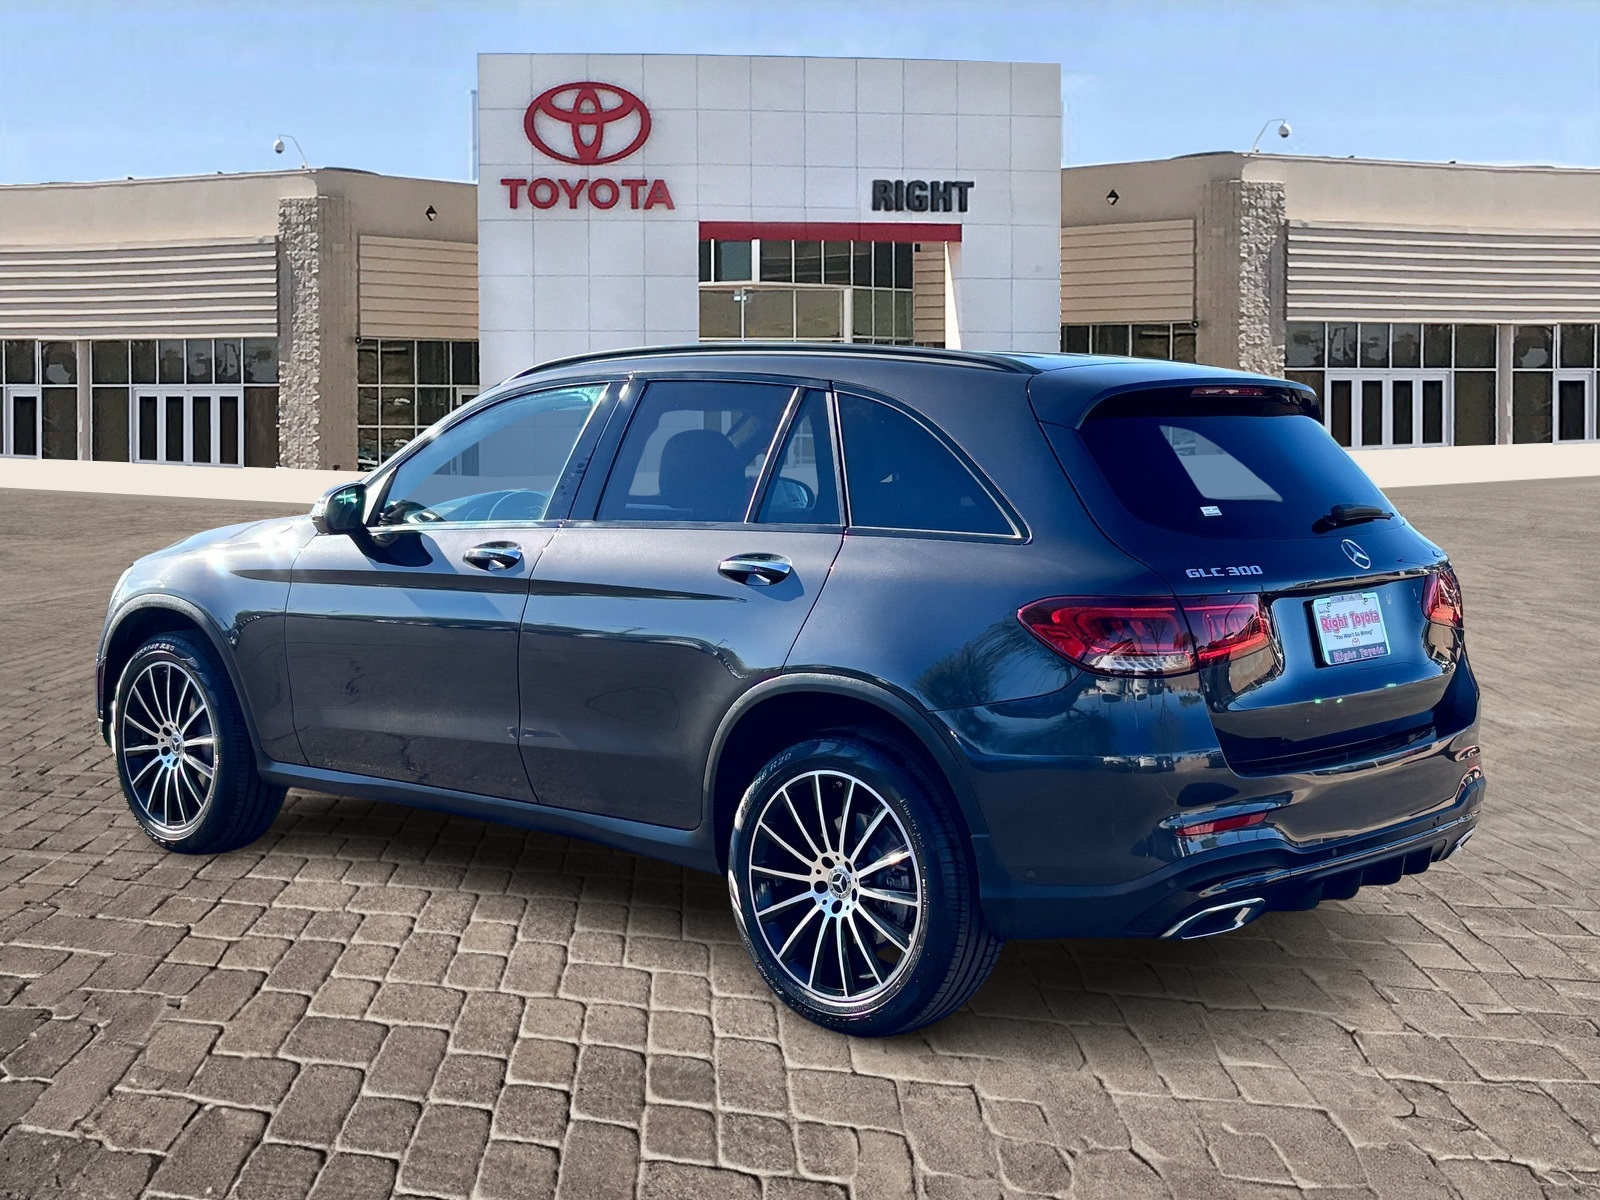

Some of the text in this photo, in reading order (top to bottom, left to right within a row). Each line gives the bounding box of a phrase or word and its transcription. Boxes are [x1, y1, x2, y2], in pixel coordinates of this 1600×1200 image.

[500, 178, 675, 210] TOYOTA
[871, 179, 975, 213] RIGHT
[1185, 565, 1264, 578] GLC 300
[1320, 609, 1380, 633] Right Toyota
[1333, 645, 1384, 662] Right Toyota
